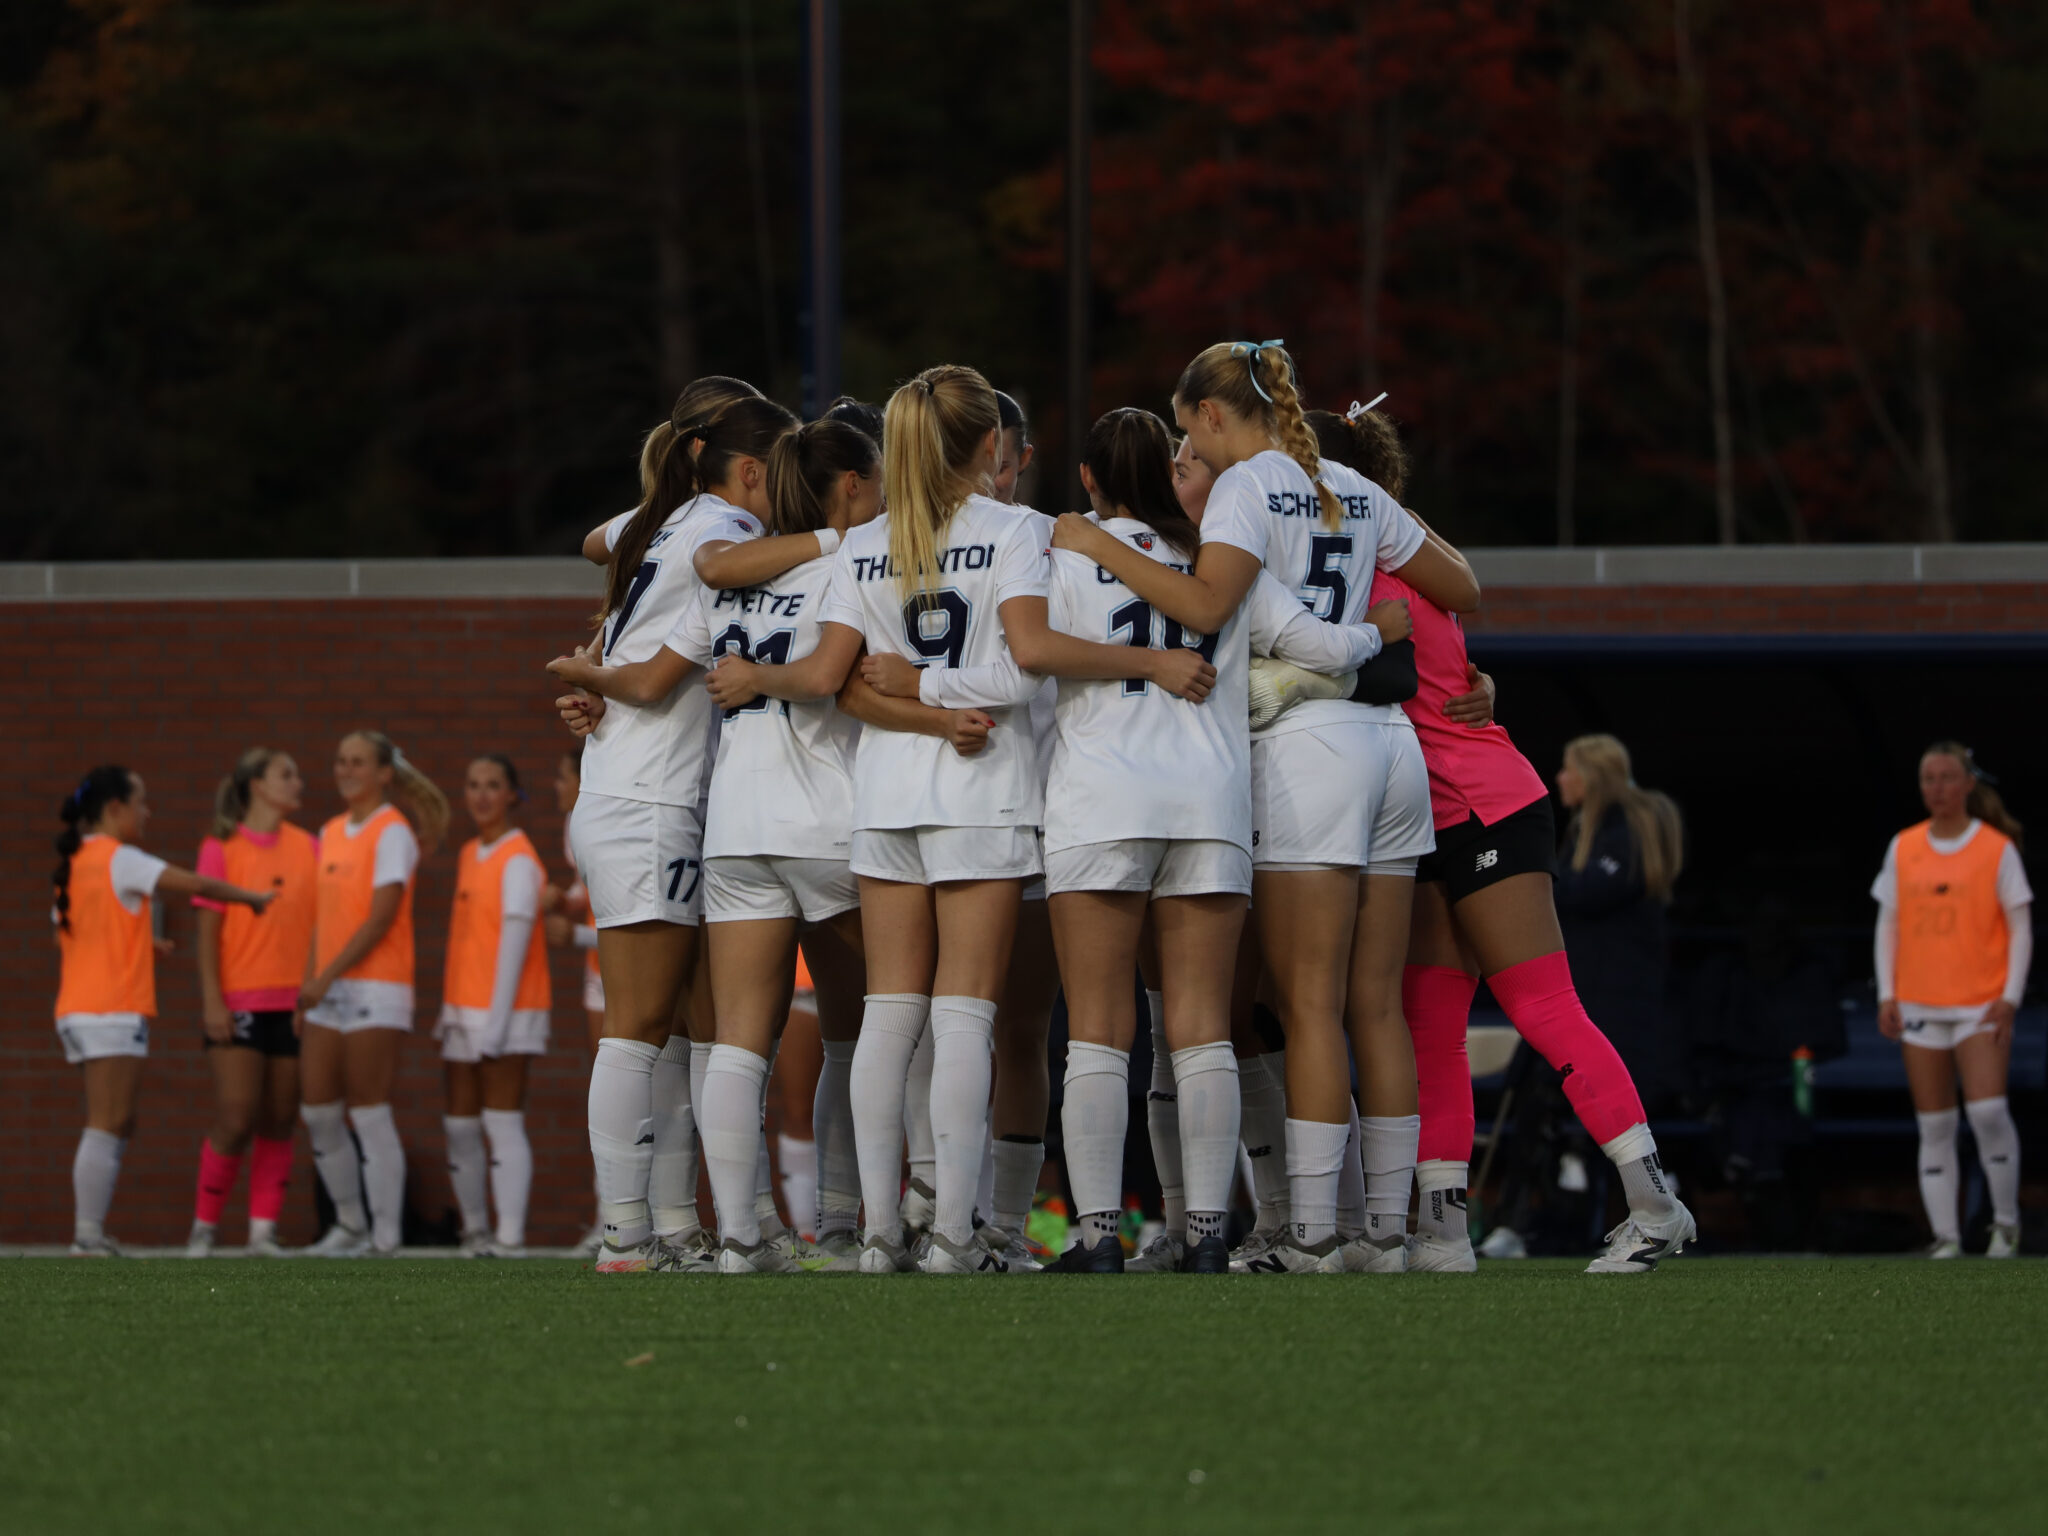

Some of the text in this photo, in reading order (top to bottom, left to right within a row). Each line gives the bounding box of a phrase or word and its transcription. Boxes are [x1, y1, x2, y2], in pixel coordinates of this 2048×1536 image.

[1303, 532, 1354, 625] 5
[901, 587, 972, 668] 9
[666, 857, 700, 902] 17
